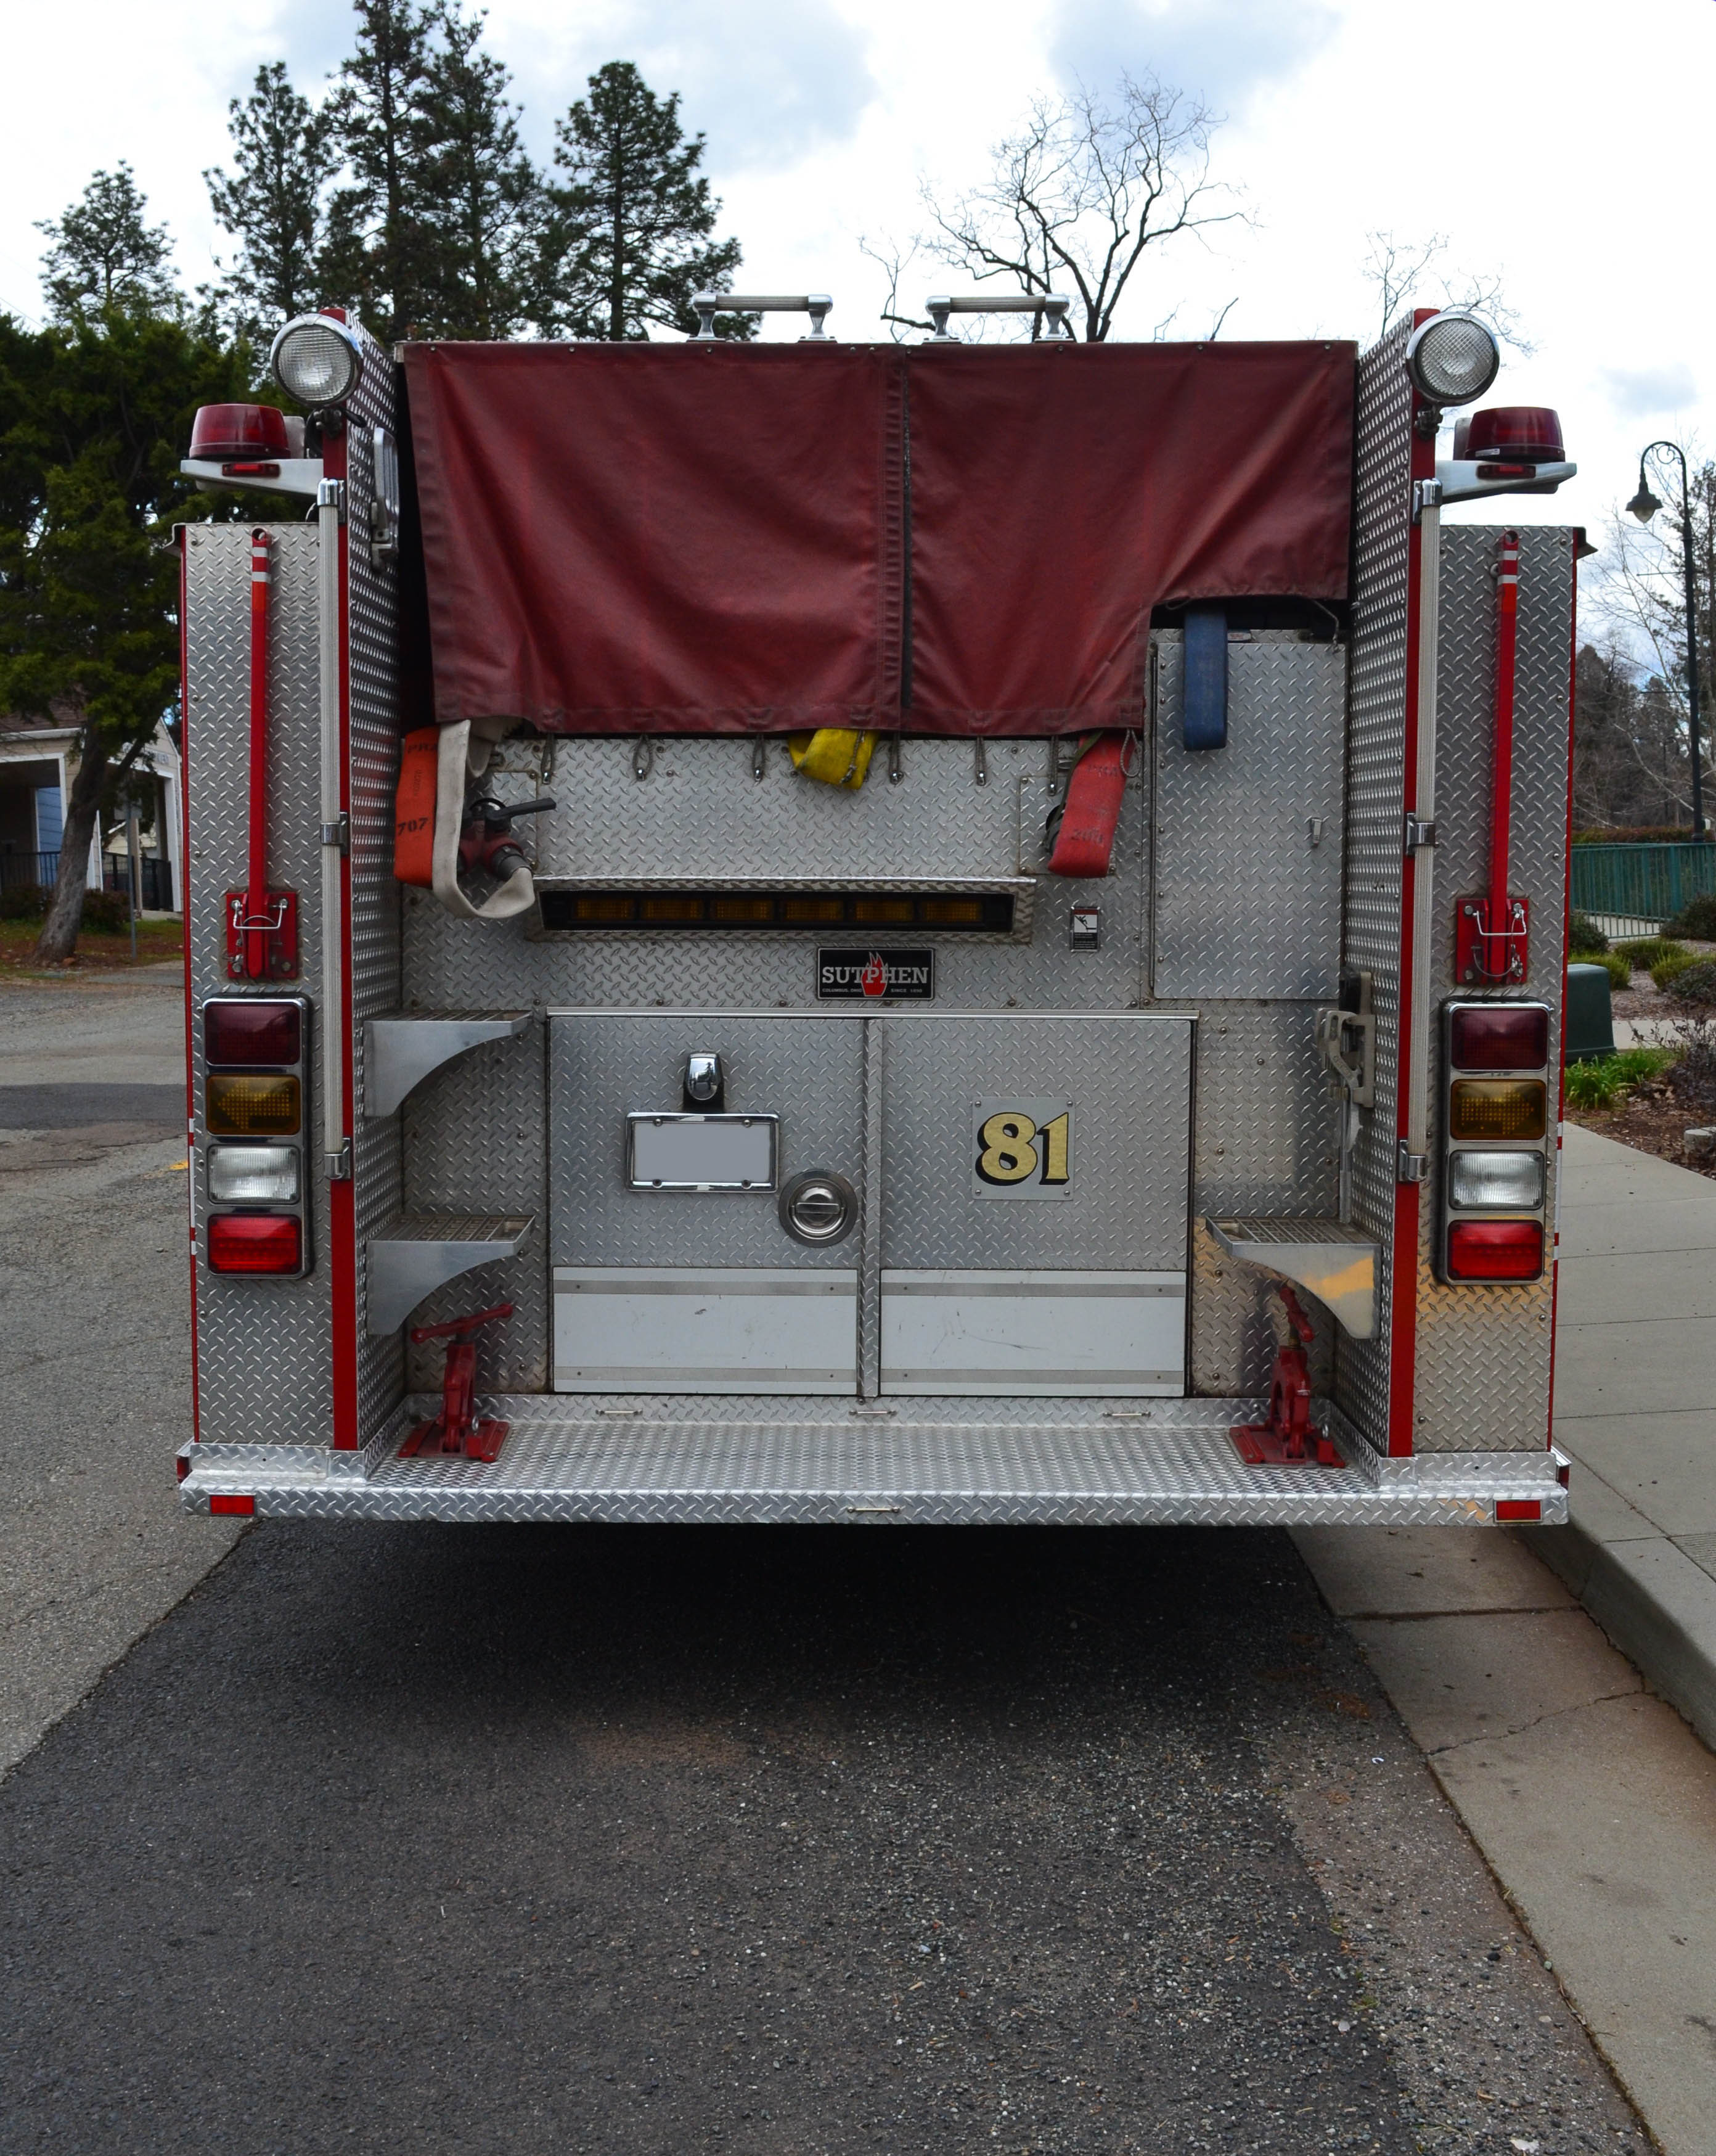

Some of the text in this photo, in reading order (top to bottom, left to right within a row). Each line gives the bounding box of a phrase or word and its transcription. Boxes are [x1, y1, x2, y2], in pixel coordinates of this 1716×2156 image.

[397, 818, 428, 835] 707
[822, 967, 929, 984] SUTPHEN
[975, 1112, 1070, 1187] 81
